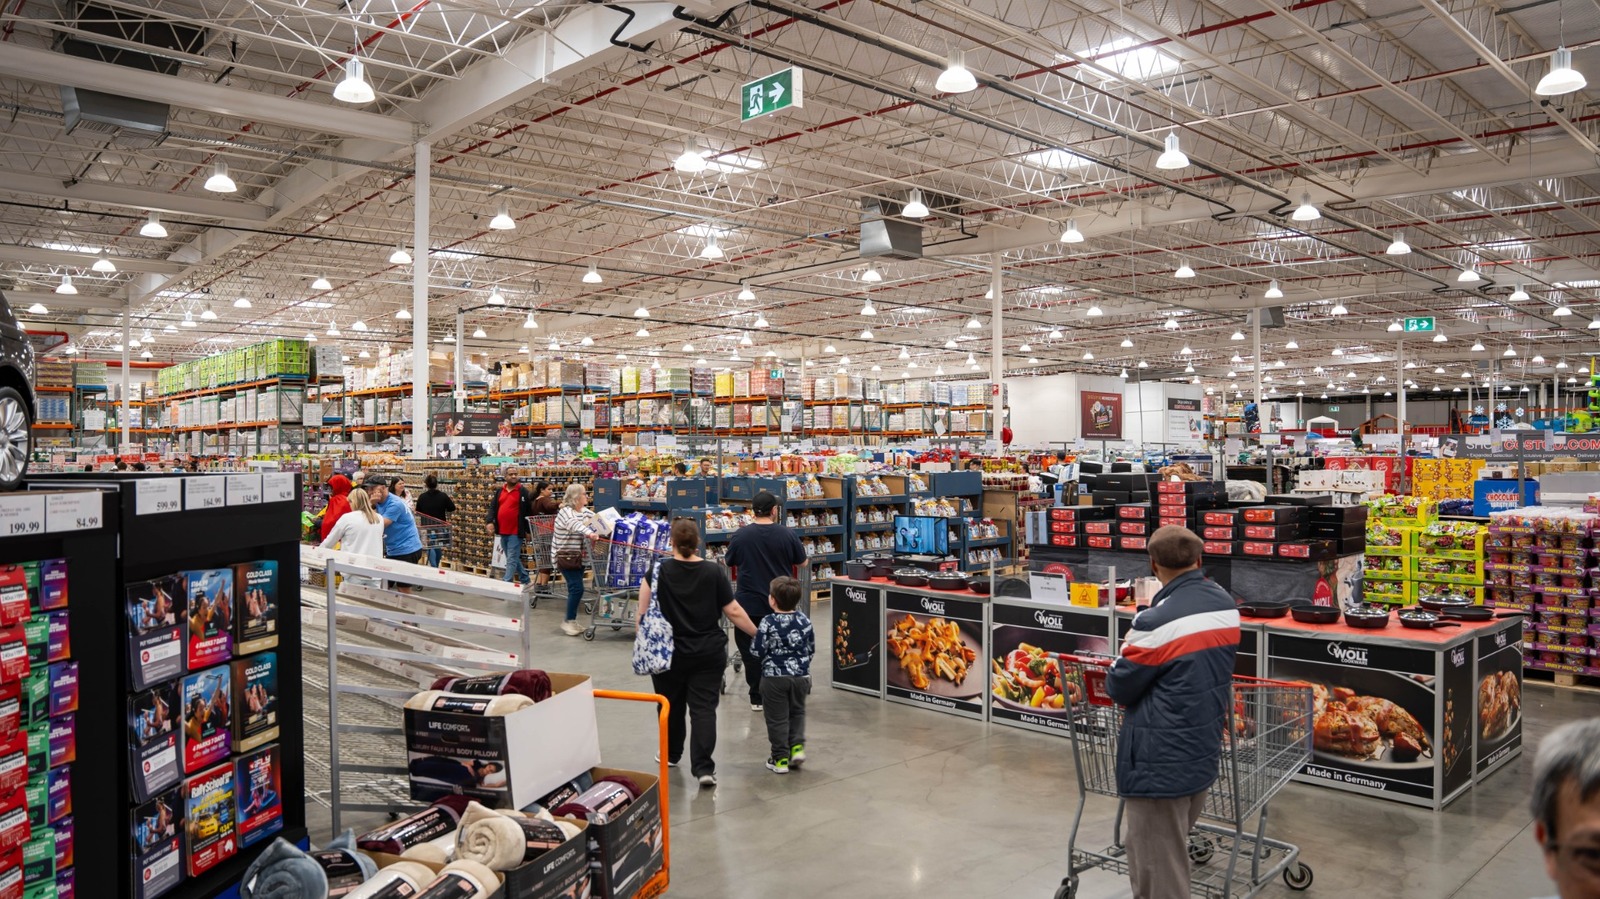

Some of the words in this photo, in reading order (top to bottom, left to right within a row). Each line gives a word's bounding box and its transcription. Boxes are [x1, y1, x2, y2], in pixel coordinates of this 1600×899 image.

[157, 500, 178, 511] 599.99
[204, 497, 222, 507] 164.99
[10, 522, 40, 534] 199.99
[76, 517, 98, 528] 84.99
[850, 592, 867, 601] WOLL
[925, 602, 944, 611] WOLL
[1039, 616, 1063, 626] WOLL
[1334, 649, 1368, 661] WOLL
[257, 662, 271, 671] CLASS
[932, 698, 956, 709] Germany
[1021, 714, 1038, 723] Made
[442, 722, 468, 732] COMFORT
[1307, 767, 1331, 778] Made
[1334, 771, 1343, 780] in
[1345, 773, 1386, 790] Germany
[626, 814, 635, 826] LIFE
[544, 861, 555, 874] LIFE
[555, 848, 576, 867] COMFORT
